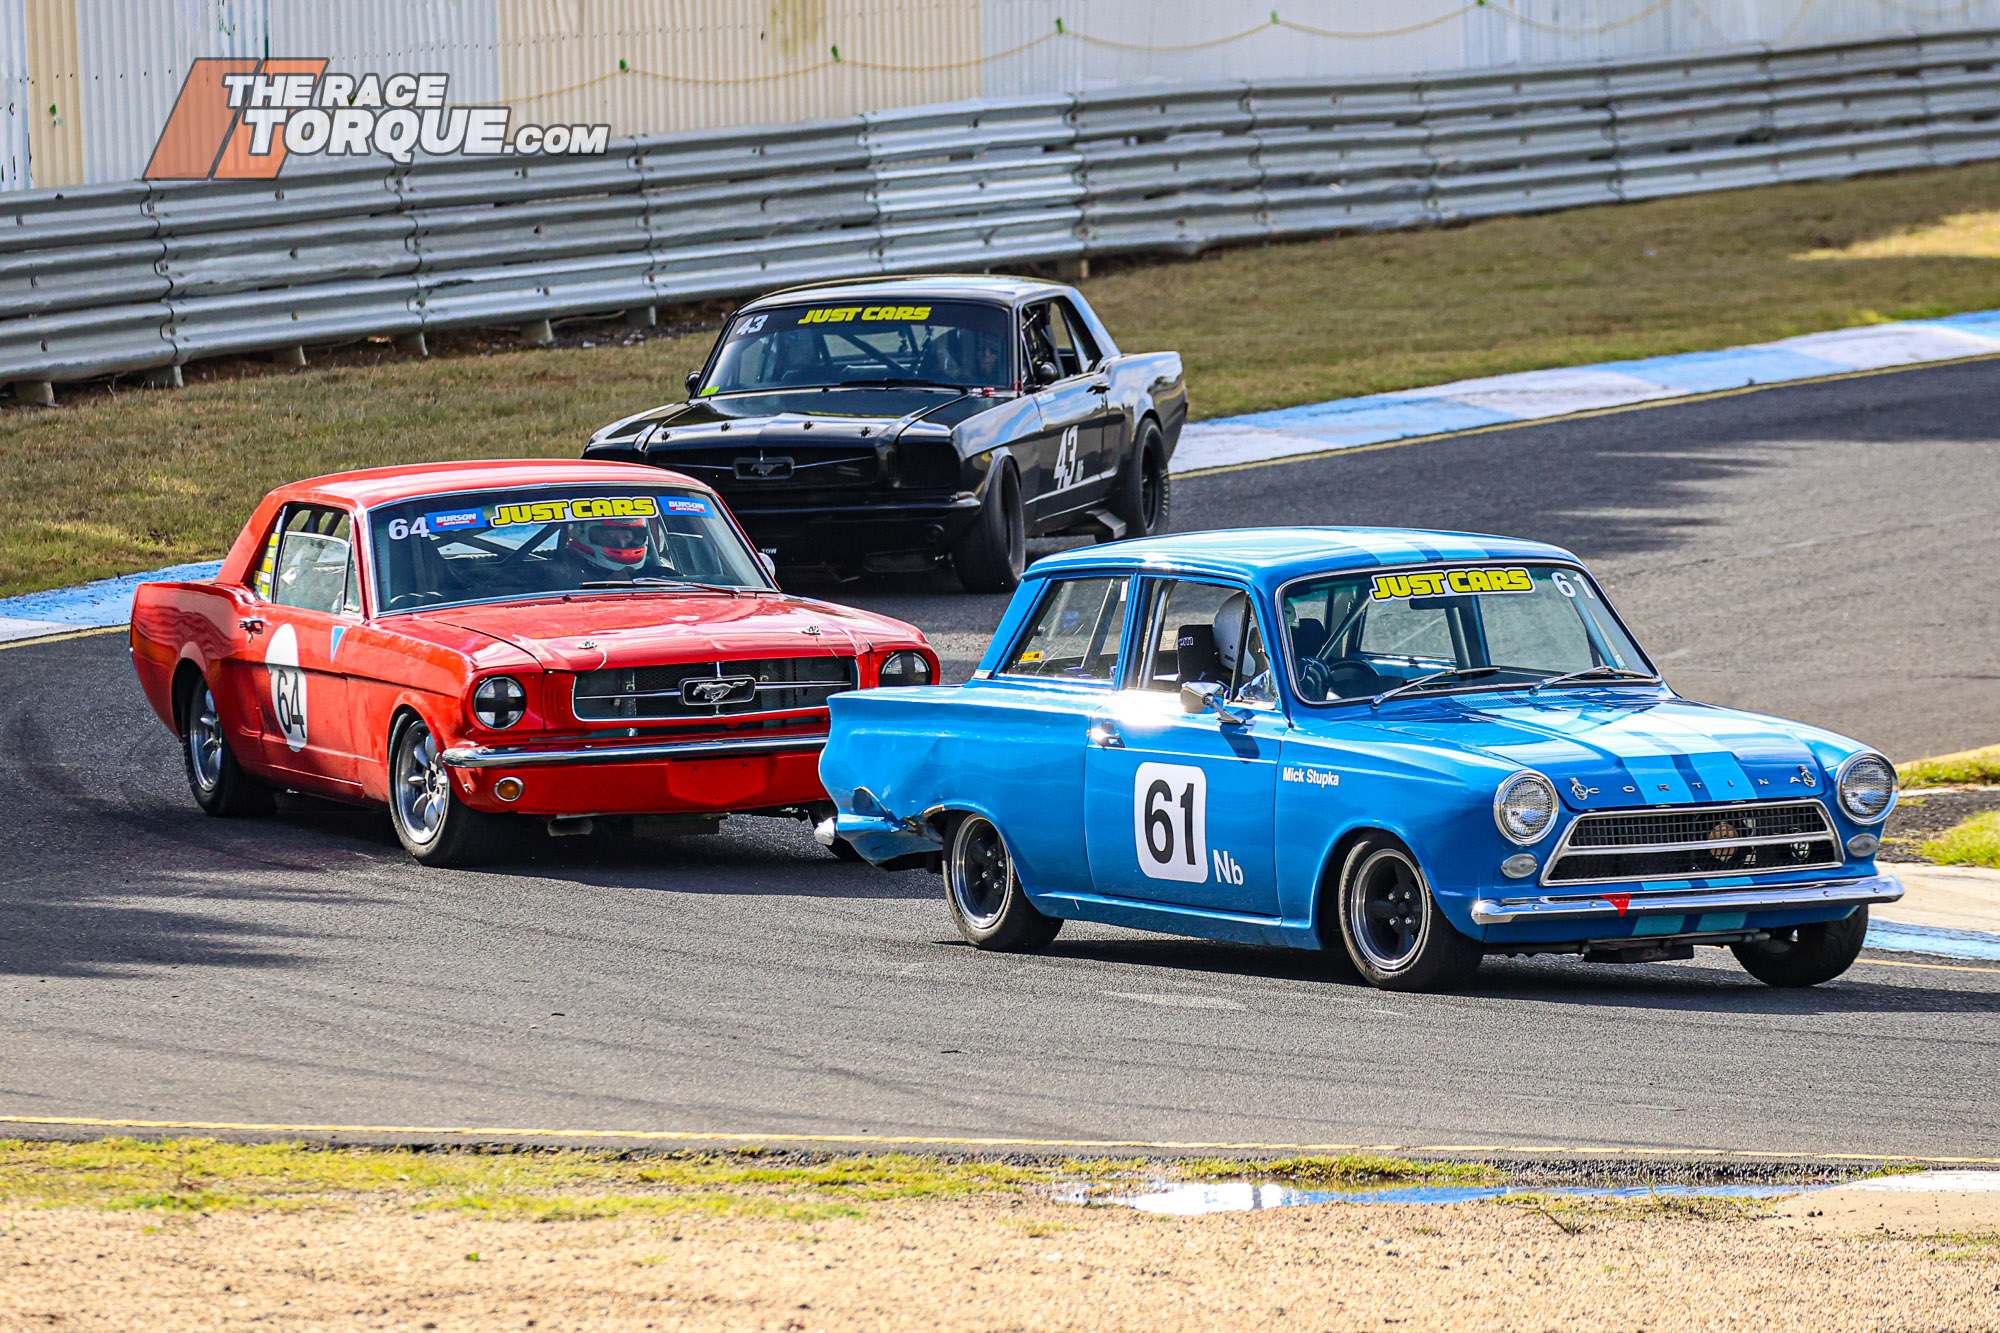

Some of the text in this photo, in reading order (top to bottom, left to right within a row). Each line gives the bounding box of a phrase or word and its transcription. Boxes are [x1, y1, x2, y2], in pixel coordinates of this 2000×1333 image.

[736, 315, 769, 336] 43
[798, 306, 932, 325] JUST CARS
[1053, 424, 1080, 490] 43
[436, 513, 477, 523] BURSON
[493, 499, 657, 526] JUST CARS
[668, 500, 705, 510] BURSON
[388, 516, 430, 541] 64
[1374, 569, 1533, 600] JUST CARS
[1550, 571, 1595, 600] 61
[278, 669, 306, 738] 64
[1282, 766, 1340, 789] Mick Stupka
[1587, 776, 1802, 795] CORTINA
[1144, 778, 1197, 866] 61
[1212, 849, 1245, 886] Nb
